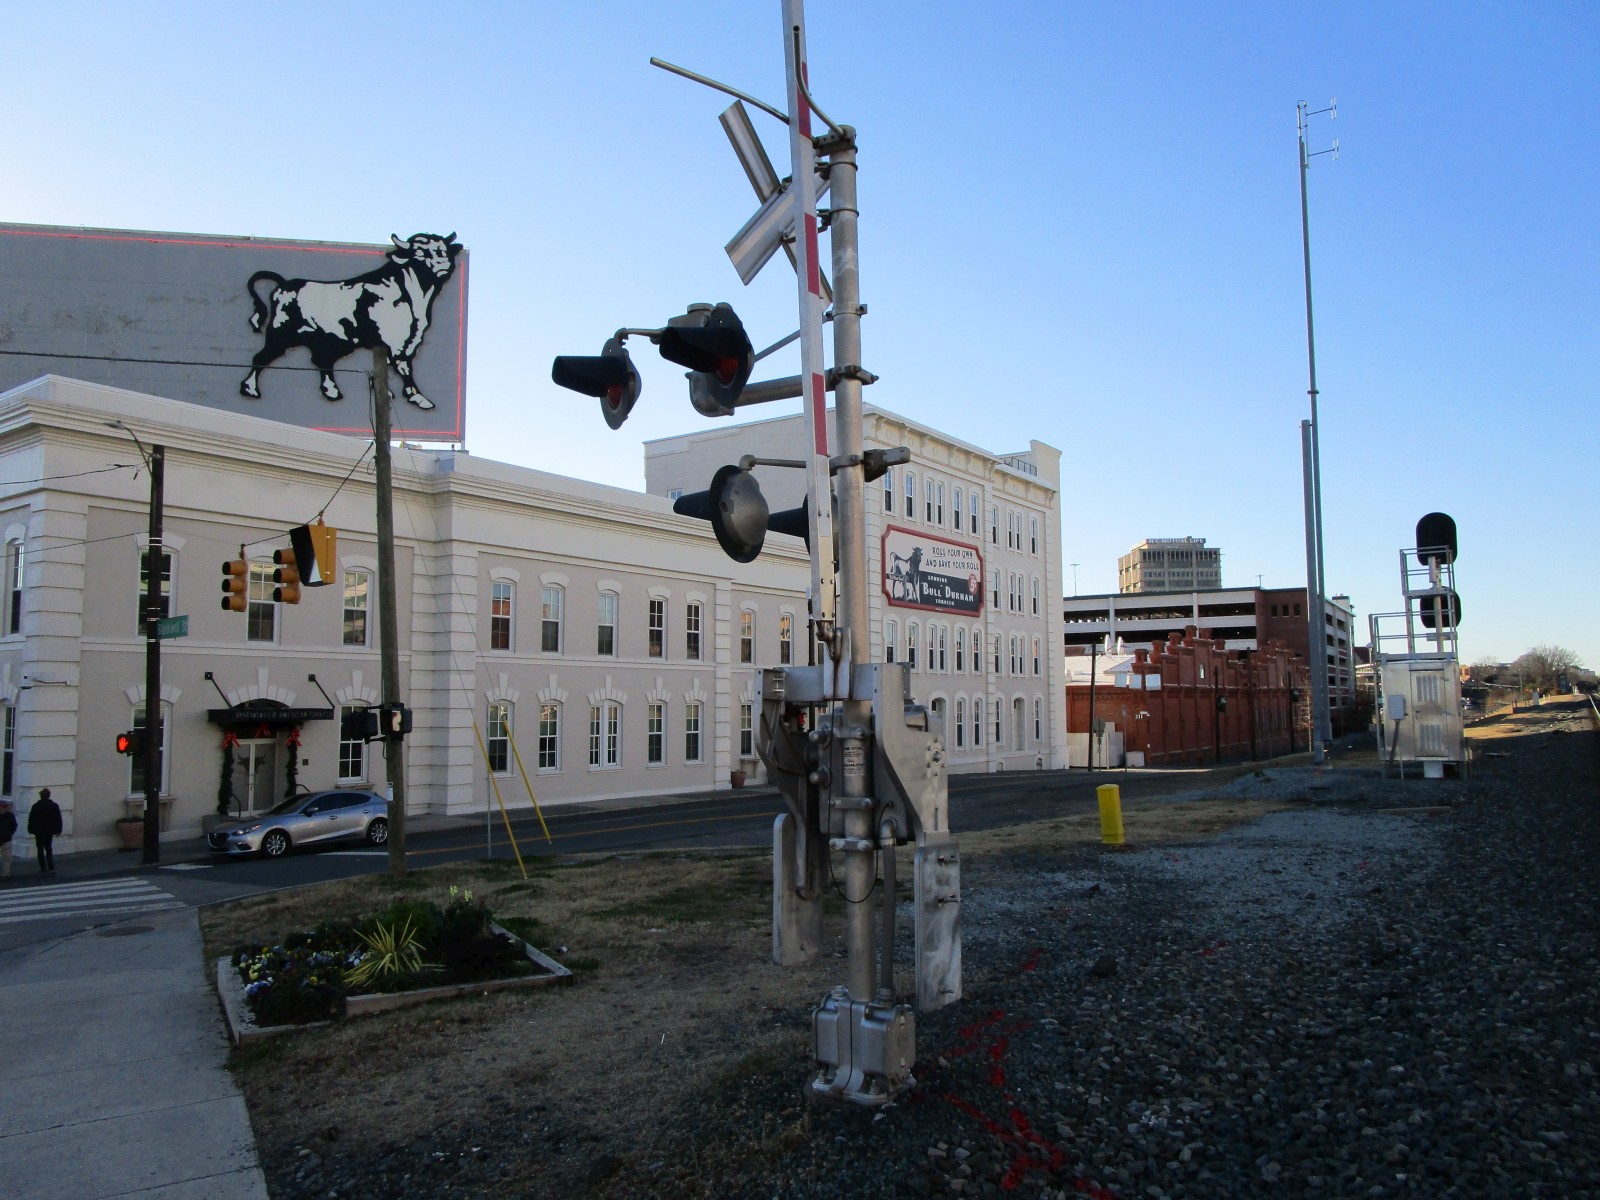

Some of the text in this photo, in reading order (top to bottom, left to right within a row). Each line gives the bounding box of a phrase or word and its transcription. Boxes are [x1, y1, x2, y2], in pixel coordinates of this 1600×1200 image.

[932, 547, 973, 559] ROLL YOUR OWN
[926, 558, 979, 571] AND SAVE YOUR ROLL
[945, 586, 974, 602] DURHAM
[935, 598, 955, 606] TOBACCO
